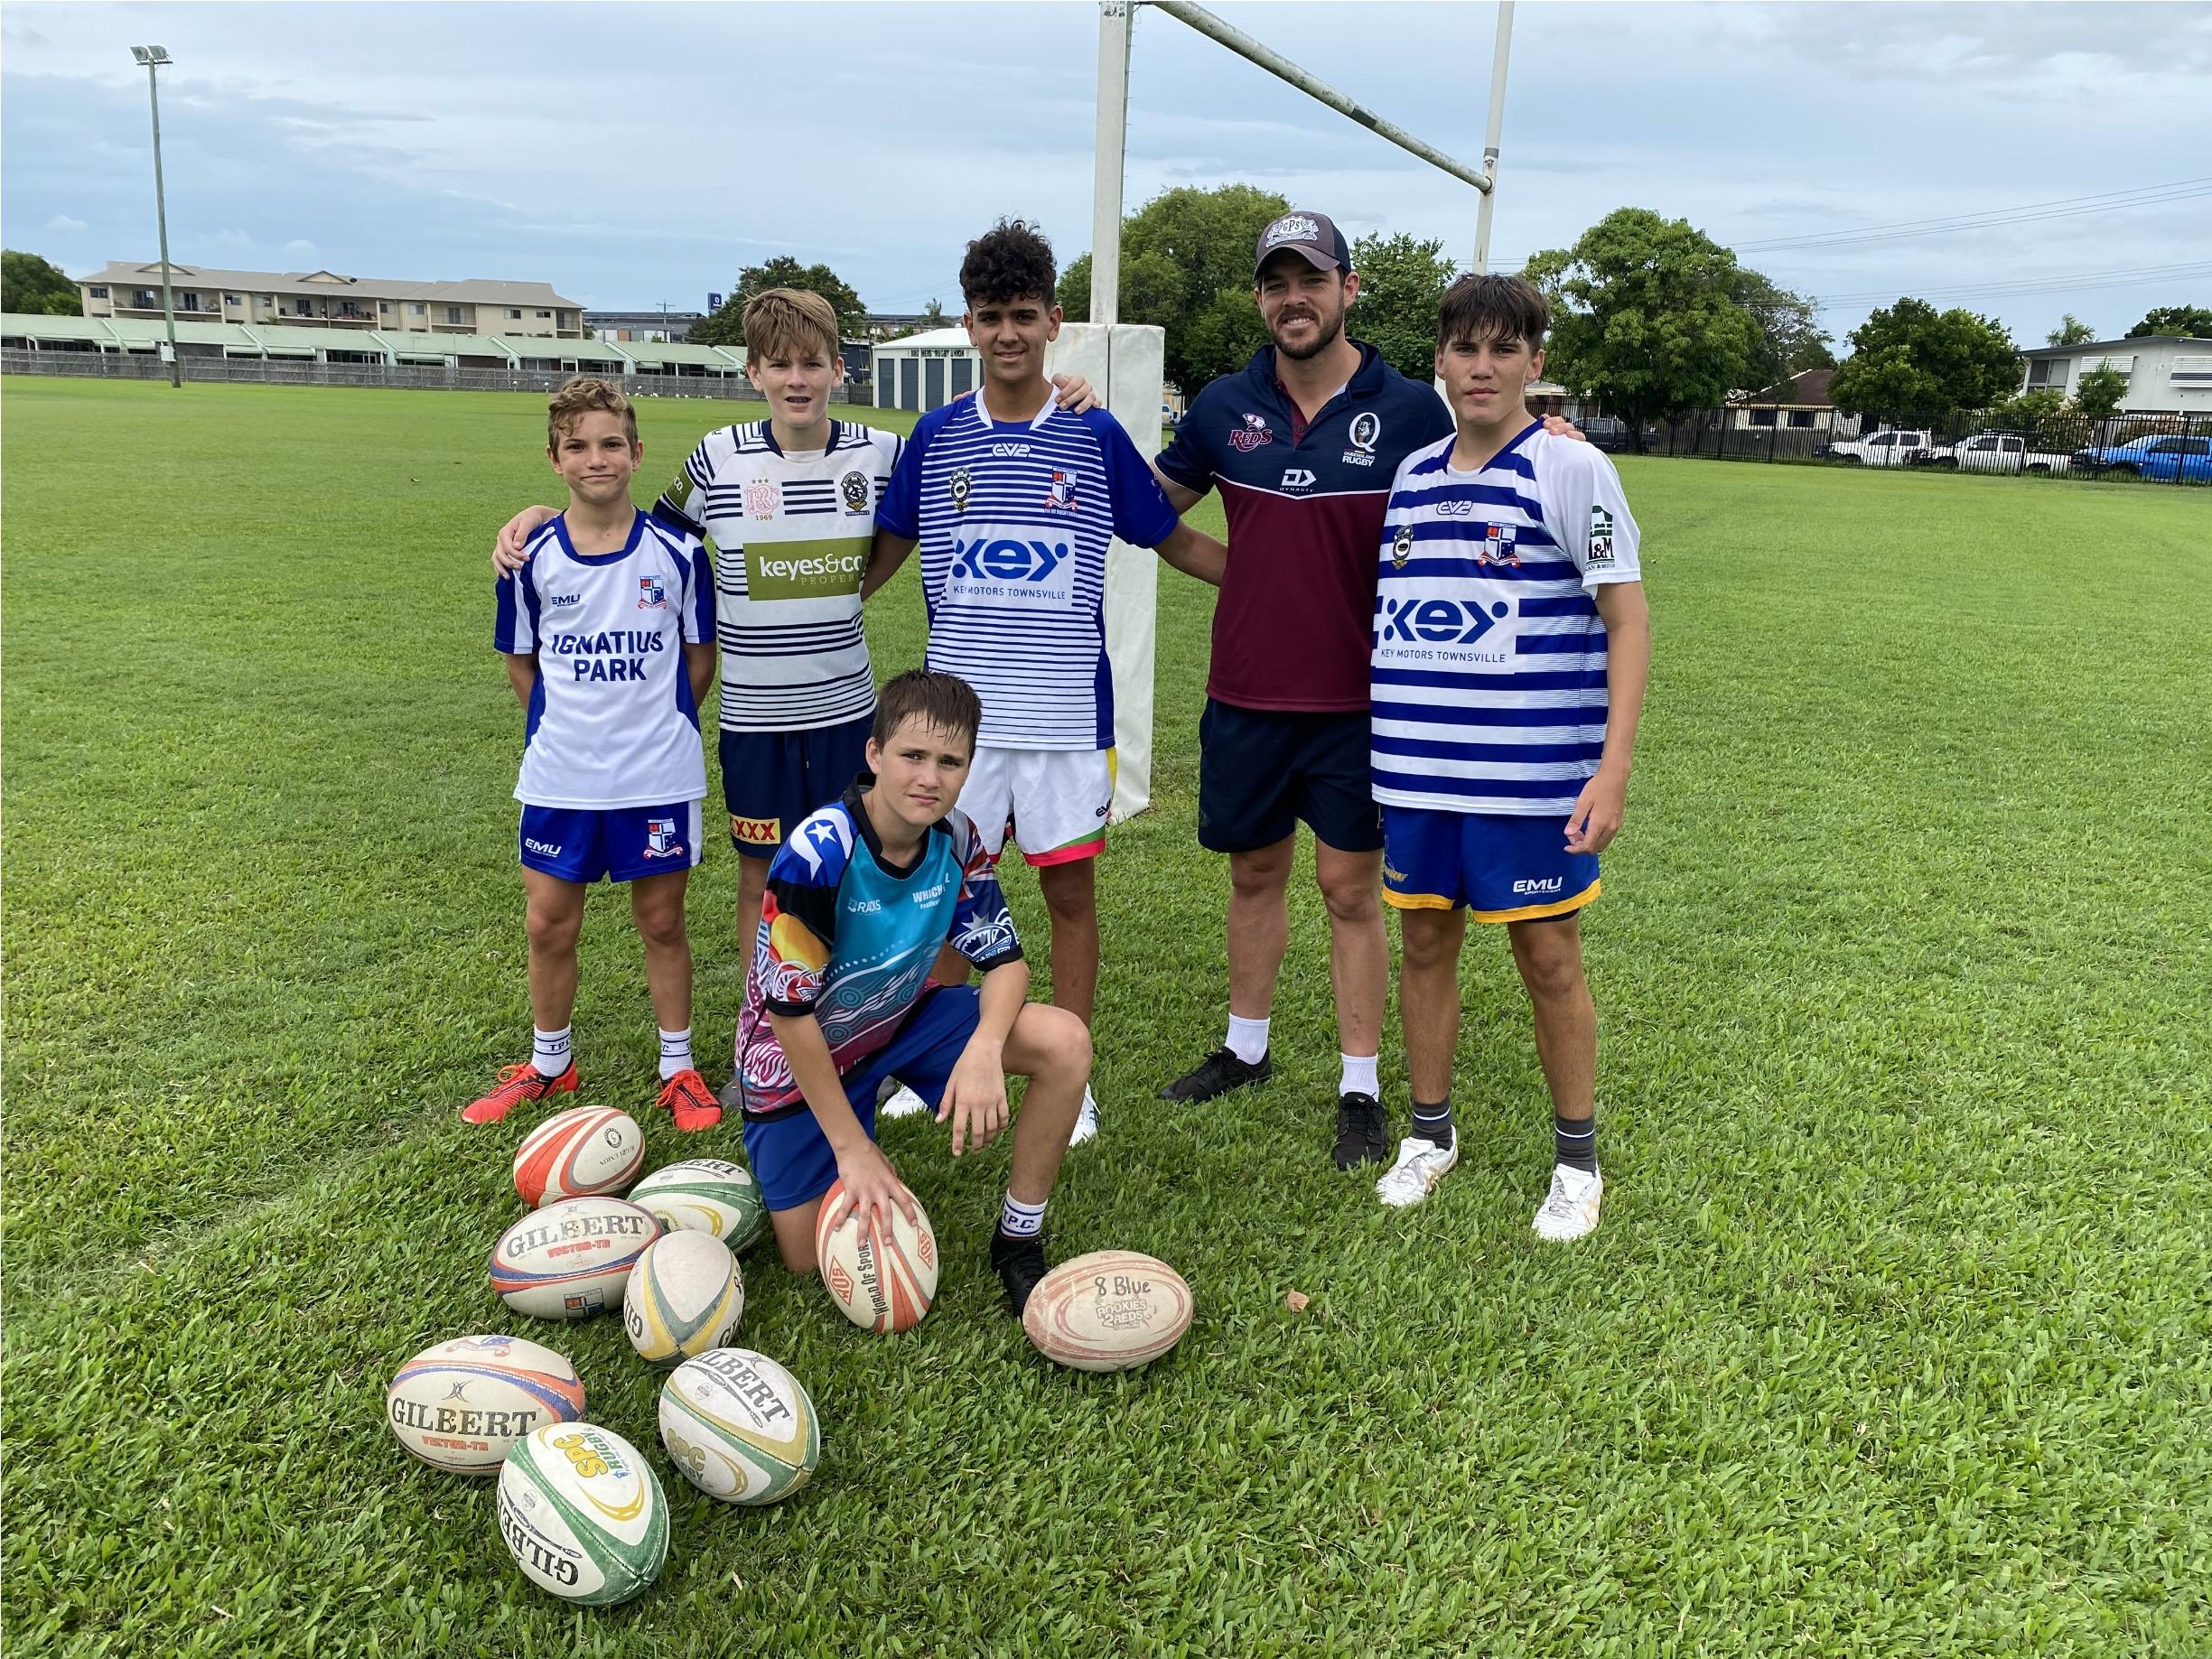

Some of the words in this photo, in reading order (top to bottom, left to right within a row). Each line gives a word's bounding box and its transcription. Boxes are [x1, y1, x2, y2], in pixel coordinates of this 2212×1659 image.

[1227, 428, 1273, 452] REDS
[1342, 455, 1375, 467] RUGBY
[800, 573, 856, 585] PROPER
[1008, 588, 1066, 600] TOWNSVILLE
[551, 630, 664, 655] IGNATIUS
[1381, 648, 1395, 657] KEY
[1397, 649, 1433, 660] MOTORS
[1437, 651, 1506, 663] TOWNSVILLE
[574, 657, 648, 682] PARK
[732, 818, 776, 841] XXX
[525, 837, 562, 855] EMU
[1513, 876, 1563, 893] EMU
[506, 1216, 645, 1259] GILBERT
[1094, 1276, 1107, 1296] 8
[1114, 1276, 1152, 1296] Blue
[1096, 1299, 1148, 1319] ROOKIES
[692, 1350, 790, 1423] ILBERT
[392, 1397, 537, 1438] GILBERT
[553, 1433, 609, 1478] SPC
[579, 1432, 623, 1470] RUGBY
